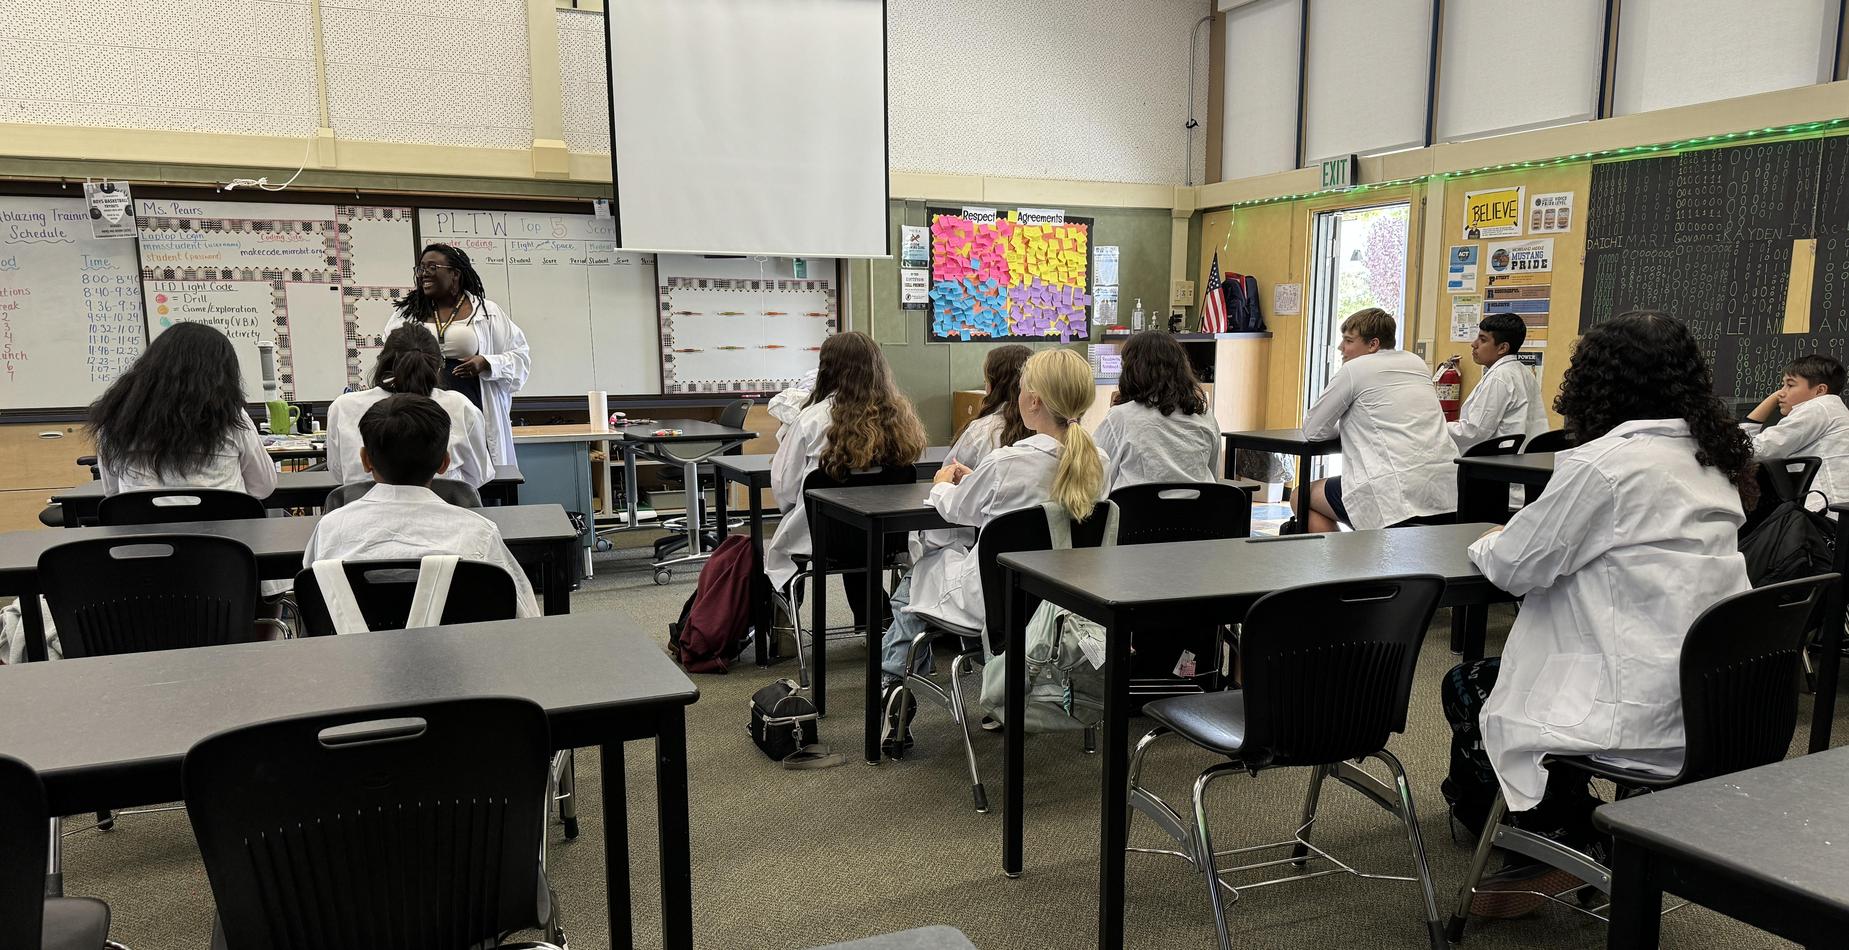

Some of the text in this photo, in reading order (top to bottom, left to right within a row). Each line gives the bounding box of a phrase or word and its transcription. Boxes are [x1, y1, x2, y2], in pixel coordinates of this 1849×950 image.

[1323, 158, 1348, 187] EXIT
[143, 202, 203, 215] Ms. Peairs
[1472, 200, 1517, 222] BELIEVE
[0, 211, 46, 227] blazing
[962, 210, 1063, 225] Respect Agreements
[437, 212, 507, 237] PLTW
[520, 217, 542, 233] Top
[9, 224, 67, 240] Schedule
[141, 232, 177, 241] Laptop
[180, 233, 205, 243] Login
[260, 234, 285, 242] Coding
[1586, 236, 1623, 250] DAICHI
[1722, 228, 1783, 241] KAYDEN
[466, 239, 493, 251] Coding
[511, 241, 535, 252] Flight
[81, 254, 111, 268] Time
[146, 252, 183, 262] student
[1511, 251, 1544, 260] MUSTANG
[1511, 259, 1548, 270] PRIDE
[154, 282, 233, 295] LED Light Code
[183, 294, 208, 304] Drill
[2, 312, 9, 321] 2
[4, 323, 11, 332] 3
[4, 333, 13, 343] 4
[4, 344, 12, 354] 5
[0, 351, 28, 361] unch
